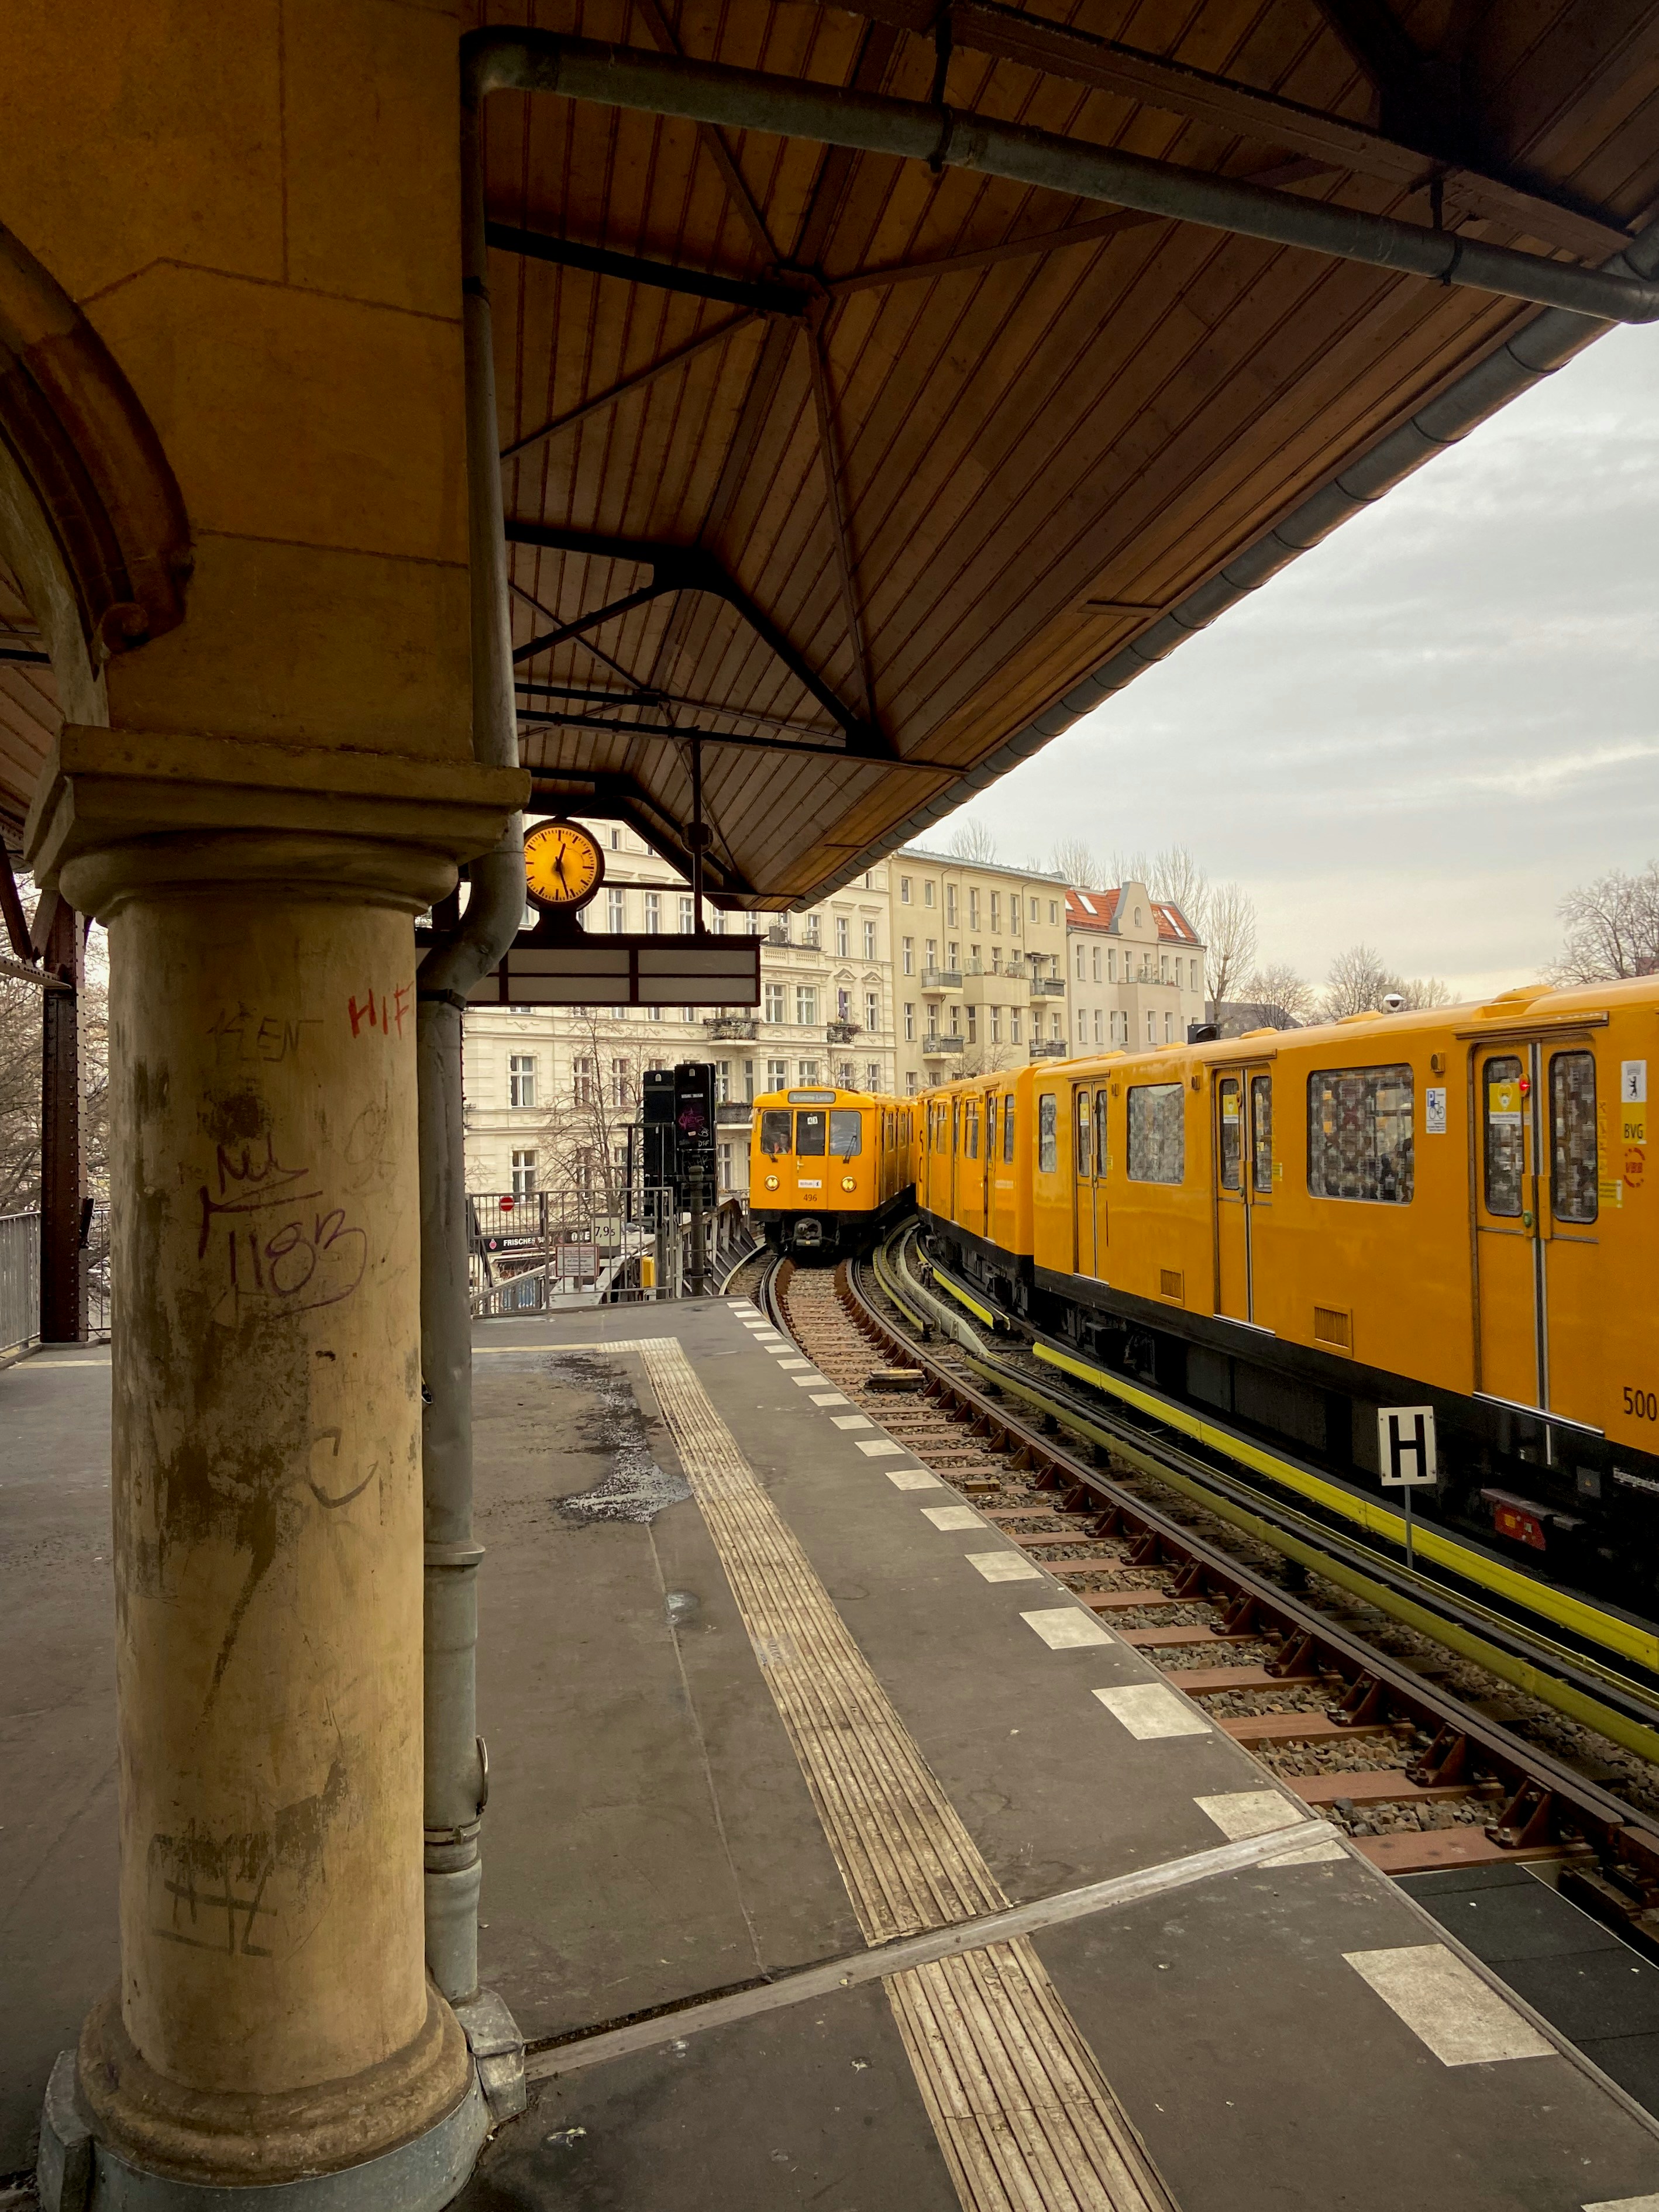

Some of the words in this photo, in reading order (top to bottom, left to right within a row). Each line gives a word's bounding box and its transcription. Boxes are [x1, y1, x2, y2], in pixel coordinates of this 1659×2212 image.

[1624, 1123, 1643, 1139] BVG
[1623, 1386, 1658, 1422] 500
[1388, 1414, 1427, 1479] H
